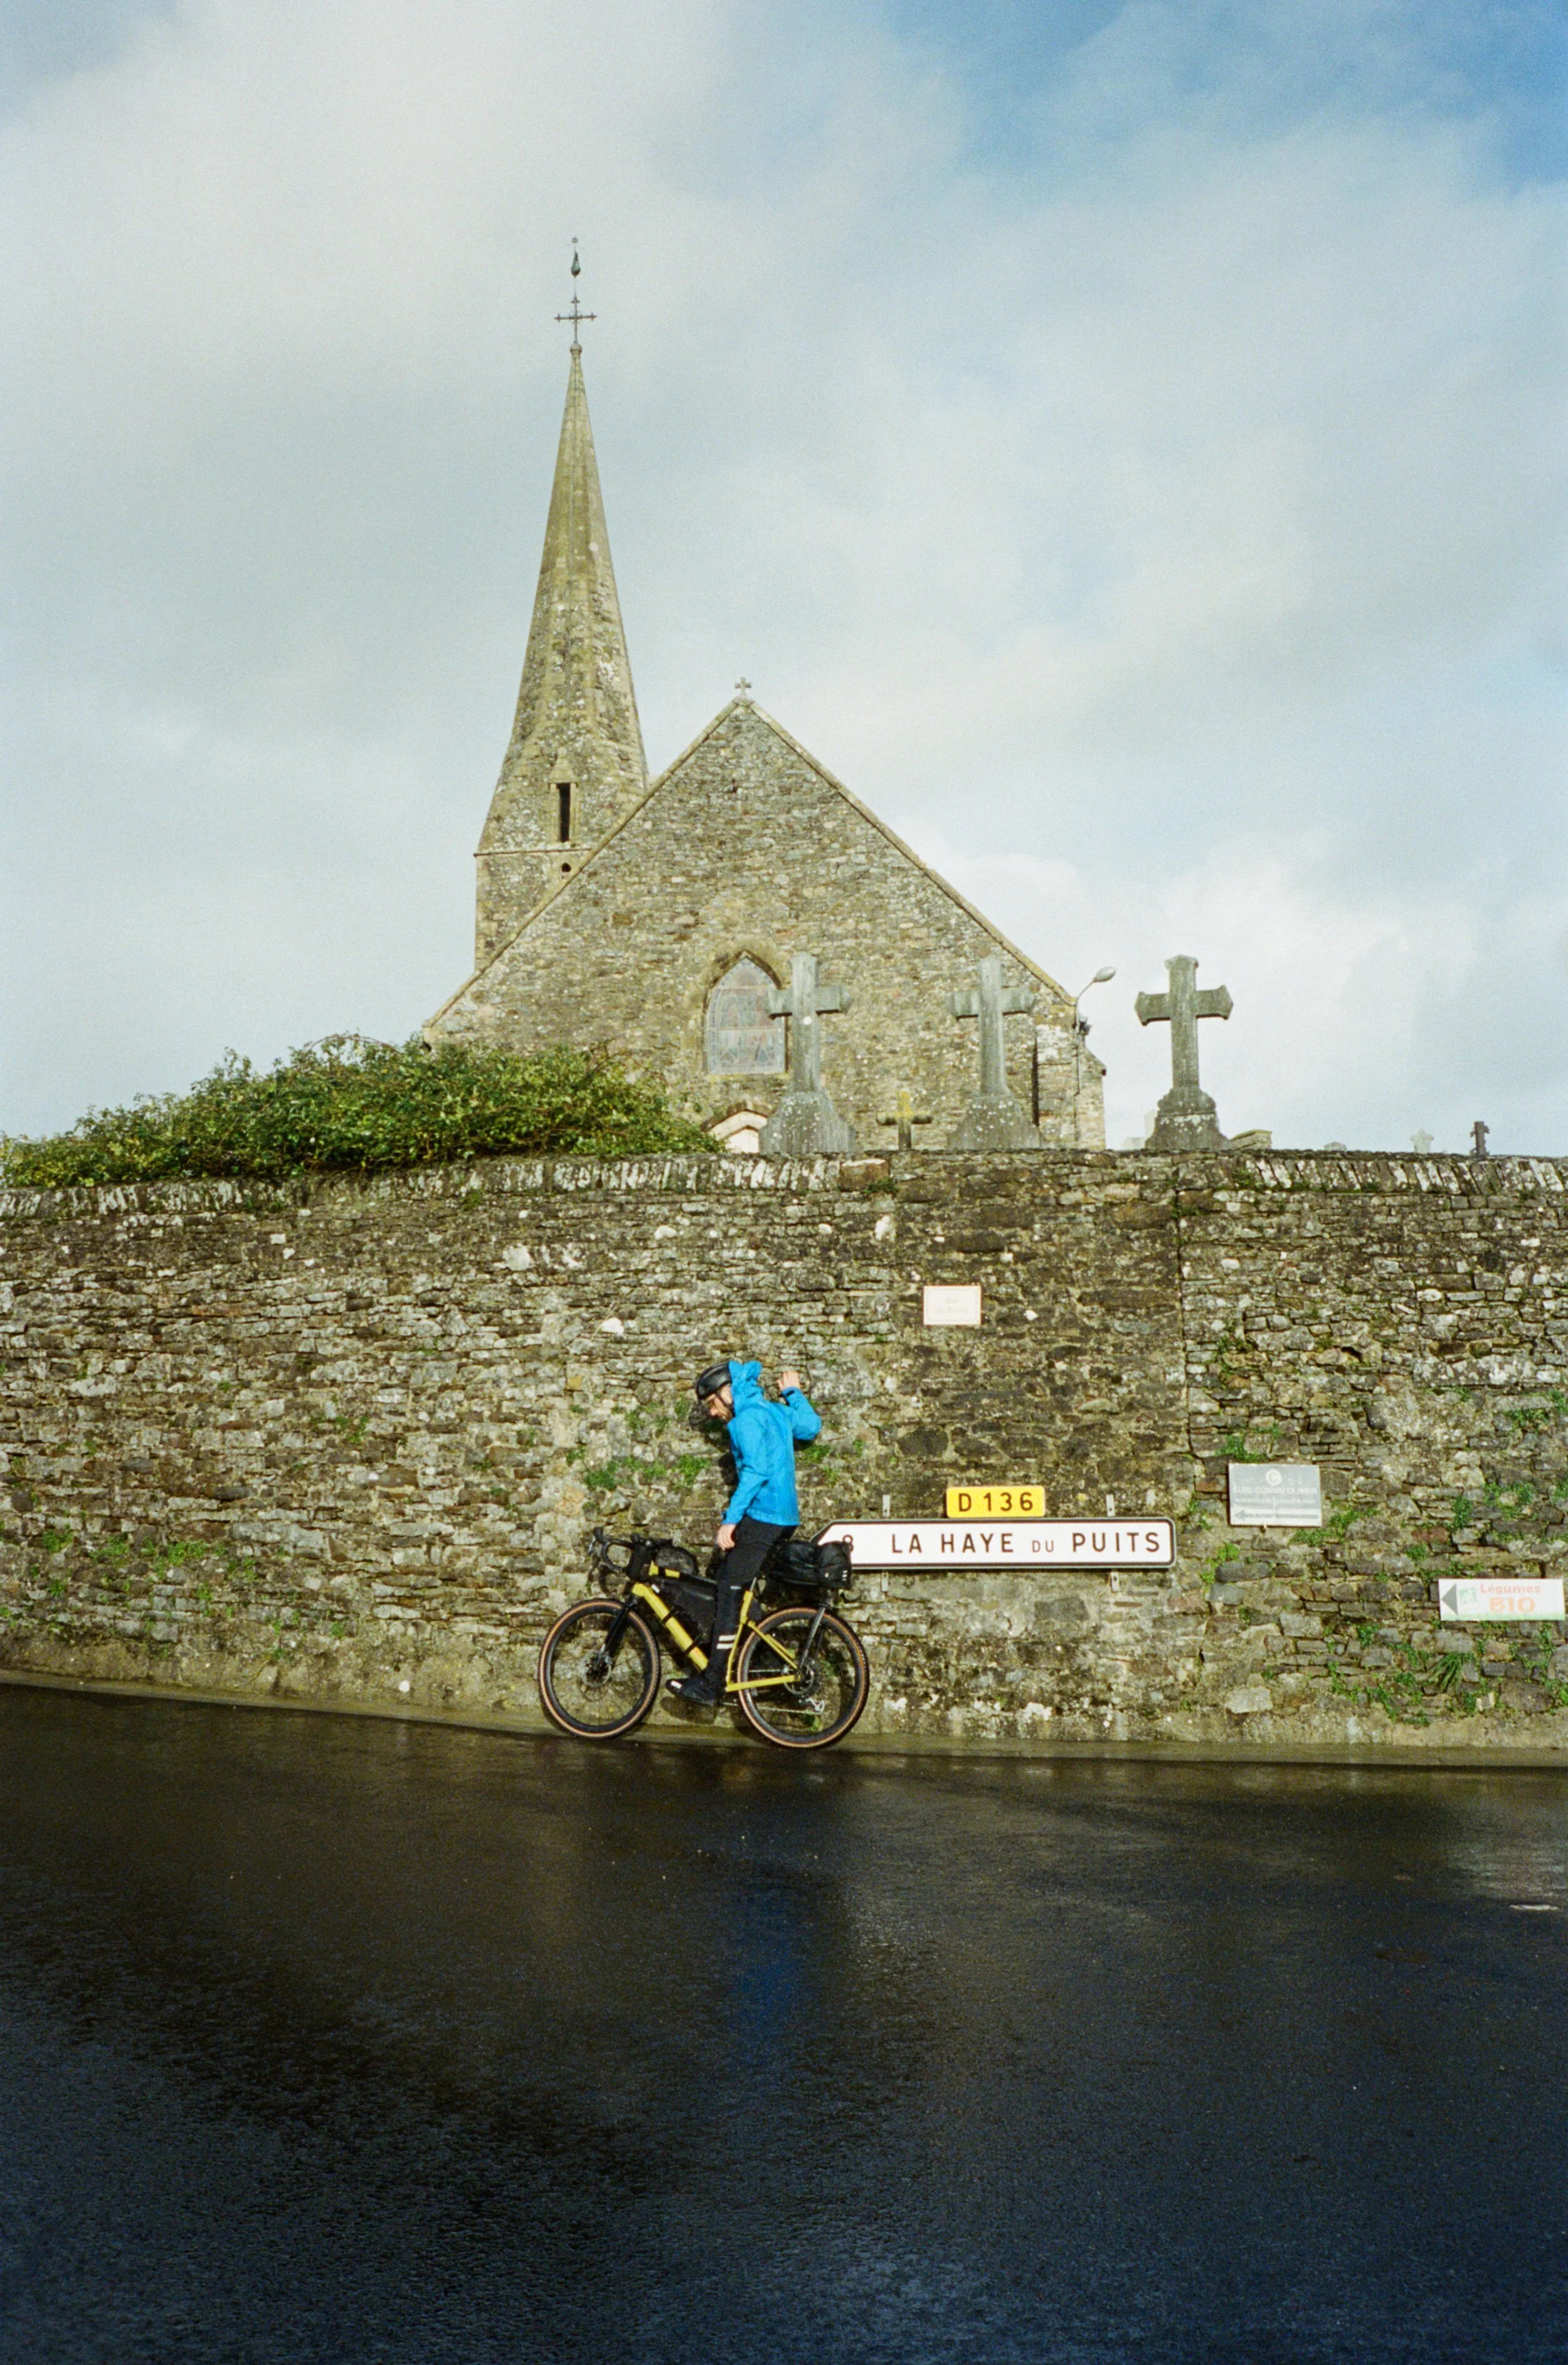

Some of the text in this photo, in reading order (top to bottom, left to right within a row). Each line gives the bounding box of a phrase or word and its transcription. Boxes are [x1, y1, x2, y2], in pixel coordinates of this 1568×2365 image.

[958, 1492, 1033, 1511] D 136
[891, 1533, 923, 1553] LA
[941, 1533, 1014, 1553] HAYE
[1032, 1540, 1054, 1553] DU
[1072, 1532, 1160, 1553] PUITS
[1480, 1584, 1540, 1594] Légumes
[1489, 1597, 1535, 1613] BIO
